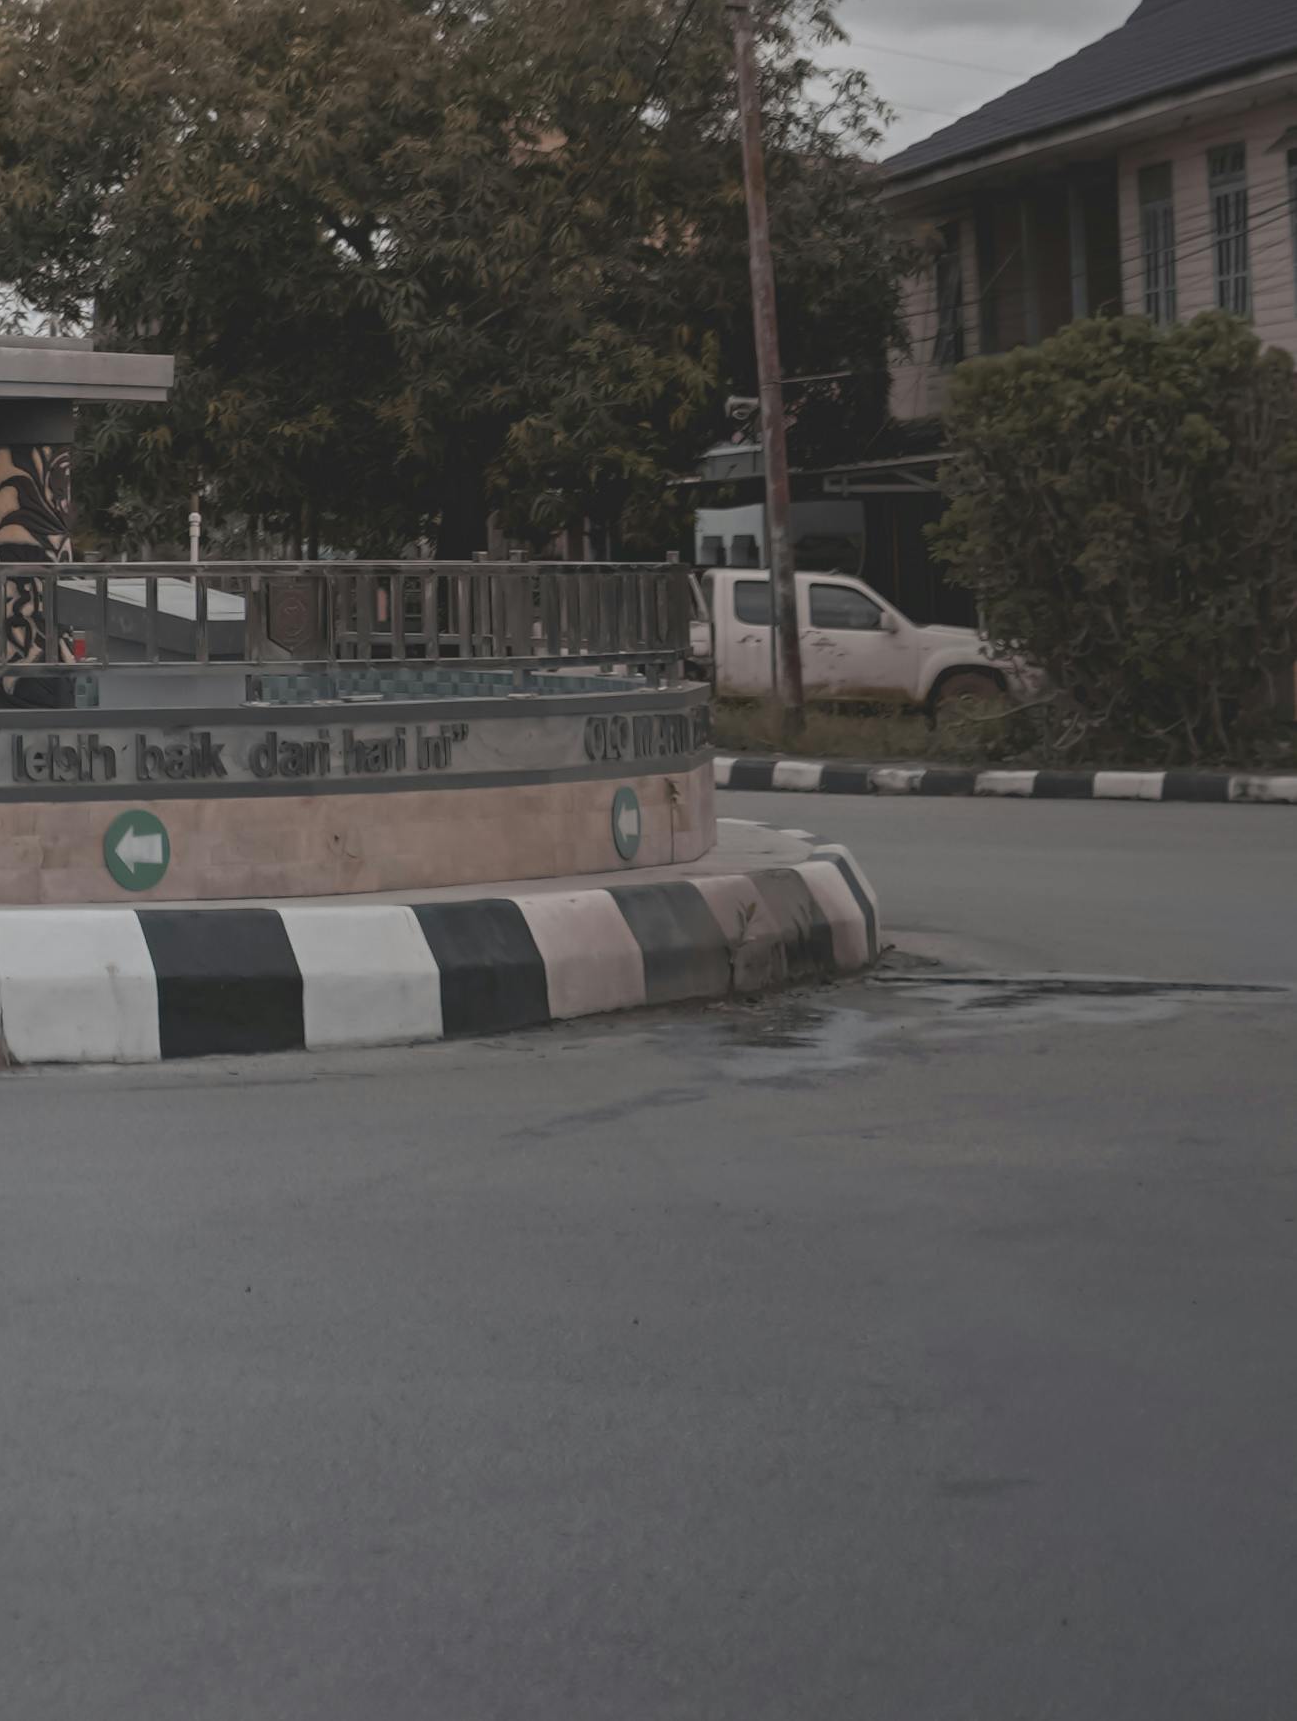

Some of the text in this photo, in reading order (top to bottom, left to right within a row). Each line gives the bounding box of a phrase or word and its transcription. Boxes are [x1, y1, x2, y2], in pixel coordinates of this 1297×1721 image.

[11, 733, 118, 783] lebih
[136, 731, 228, 781] baik
[249, 729, 331, 778] dari
[342, 728, 406, 776] hari
